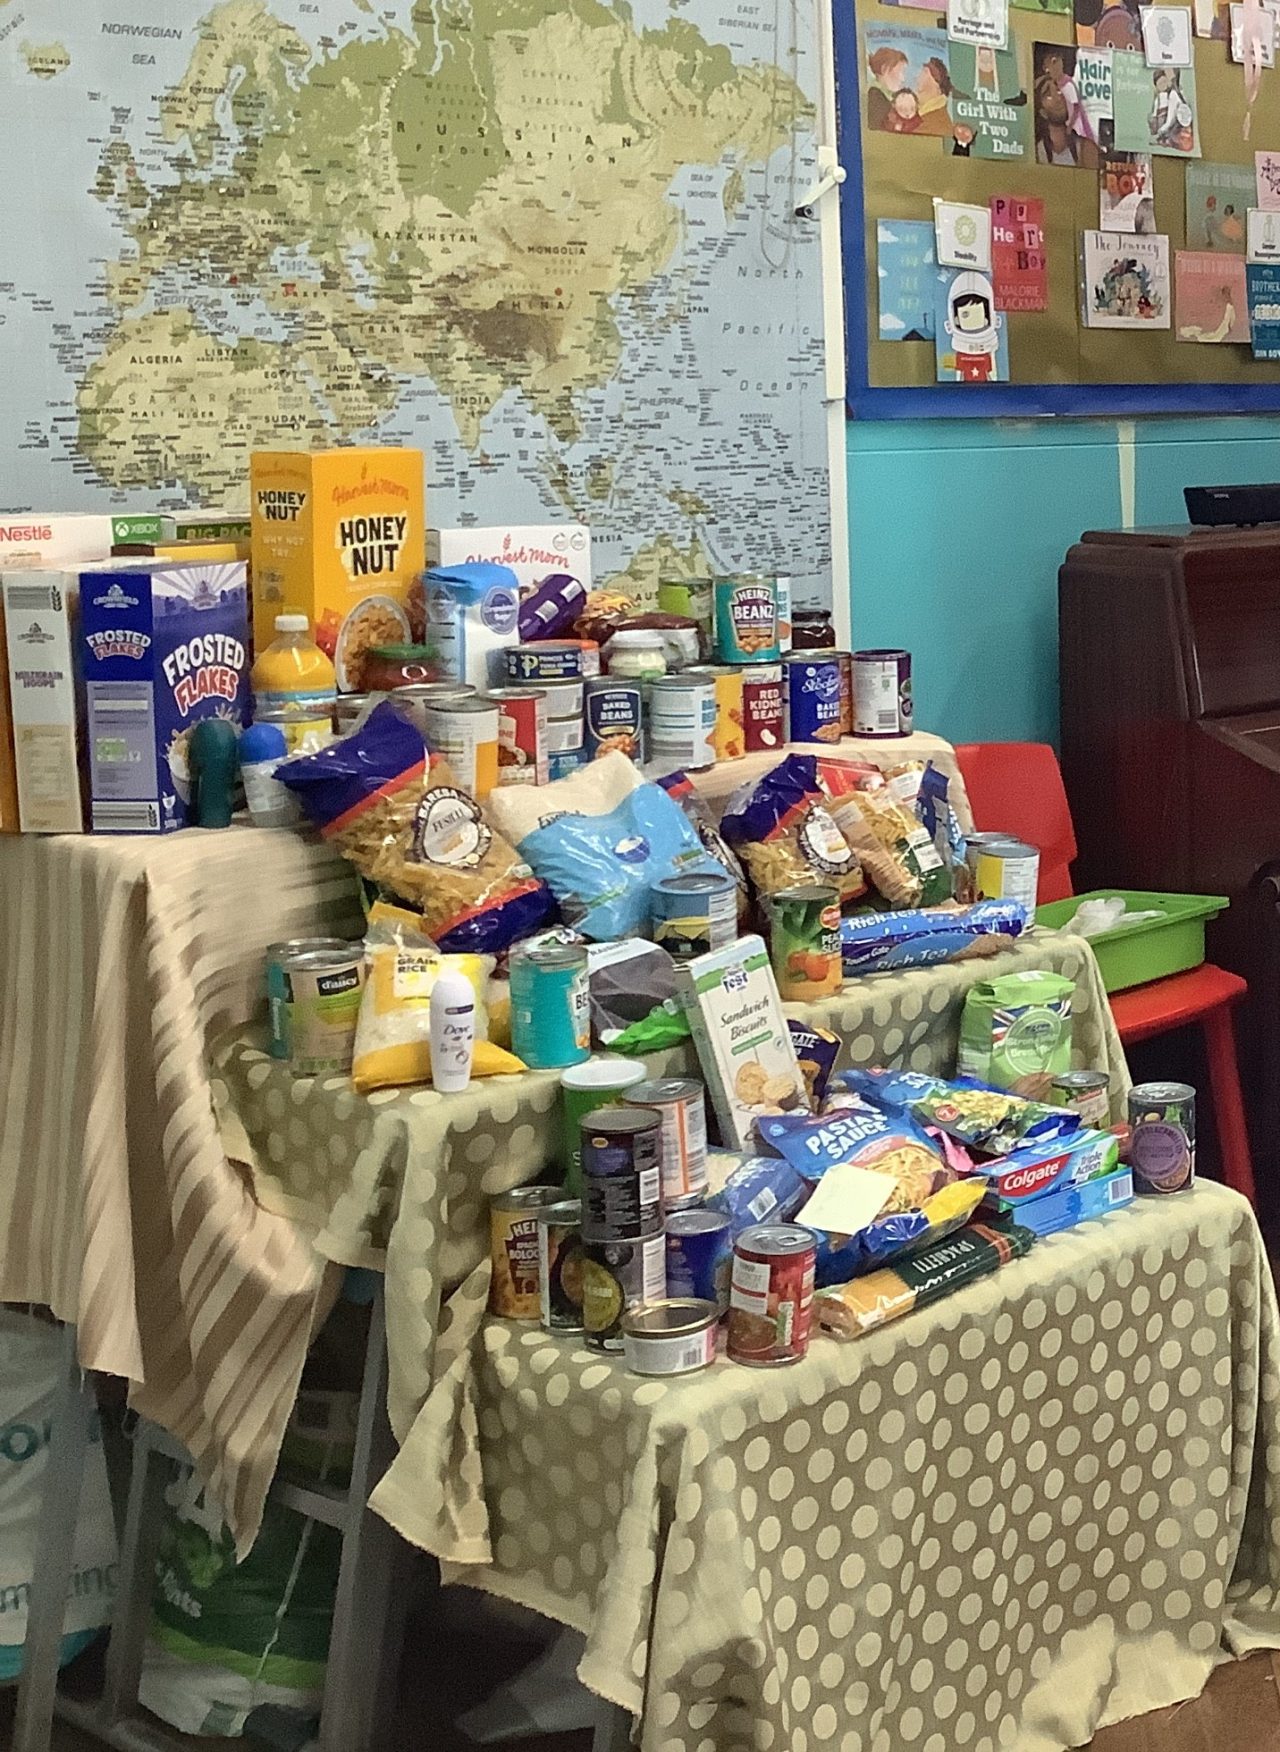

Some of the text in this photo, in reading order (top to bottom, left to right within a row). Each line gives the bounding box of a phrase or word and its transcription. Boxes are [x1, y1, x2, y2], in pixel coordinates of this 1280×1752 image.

[737, 5, 760, 15] EAST
[102, 23, 182, 39] NORWEGIAN
[719, 18, 759, 30] SIBERIAN
[132, 54, 156, 65] SEA
[1078, 58, 1111, 81] Hair
[974, 86, 999, 102] The
[1078, 81, 1111, 100] Love
[151, 95, 188, 103] NORWAY
[957, 103, 1017, 122] Girl With
[979, 121, 1008, 137] Two
[992, 138, 1024, 155] Dads
[372, 230, 478, 244] KAZAKHSTAN
[528, 246, 586, 255] MONGOLIA
[1017, 251, 1046, 271] Boy
[737, 266, 804, 280] North
[1000, 285, 1040, 297] MALORIE
[683, 306, 709, 314] JAPAN
[996, 298, 1047, 309] BLACKMAN
[360, 325, 400, 334] IRAN
[722, 322, 810, 336] Pacific
[129, 355, 183, 365] ALGERIA
[204, 349, 249, 357] LIBYAN
[739, 379, 809, 392] Ocean
[455, 396, 491, 405] INDIA
[178, 411, 214, 419] NIGER
[264, 414, 306, 424] SUDAN
[224, 423, 253, 431] CHAD
[258, 490, 306, 505] HONEY
[266, 505, 299, 521] NUT
[130, 522, 159, 534] XBOX
[187, 527, 210, 539] BIG
[340, 516, 407, 546] HONEY
[353, 544, 399, 576] NUT
[529, 549, 570, 569] Morn
[738, 590, 769, 601] HEINZ
[733, 605, 774, 620] BEANZ
[86, 629, 151, 649] FROSTED
[93, 644, 145, 660] FLAKES
[162, 634, 245, 687] FROSTED
[174, 665, 240, 716] FLAKES
[760, 688, 780, 699] RED
[602, 702, 631, 710] BAKED
[600, 710, 633, 721] BEANS
[418, 787, 459, 819] BARESA
[850, 913, 886, 931] Rich
[871, 945, 890, 957] Gate
[920, 947, 949, 962] Tea
[398, 965, 427, 974] RICE
[720, 995, 770, 1028] Sandwich
[443, 1024, 472, 1036] Dove
[730, 1016, 768, 1041] Biscuits
[806, 1114, 869, 1156] PASTA
[827, 1119, 891, 1160] SAUCE
[1080, 1151, 1103, 1168] Triple
[1004, 1162, 1060, 1190] Colgate
[1075, 1161, 1101, 1176] Action
[512, 1221, 537, 1237] HEI
[912, 1239, 977, 1274] SPAGHETTI
